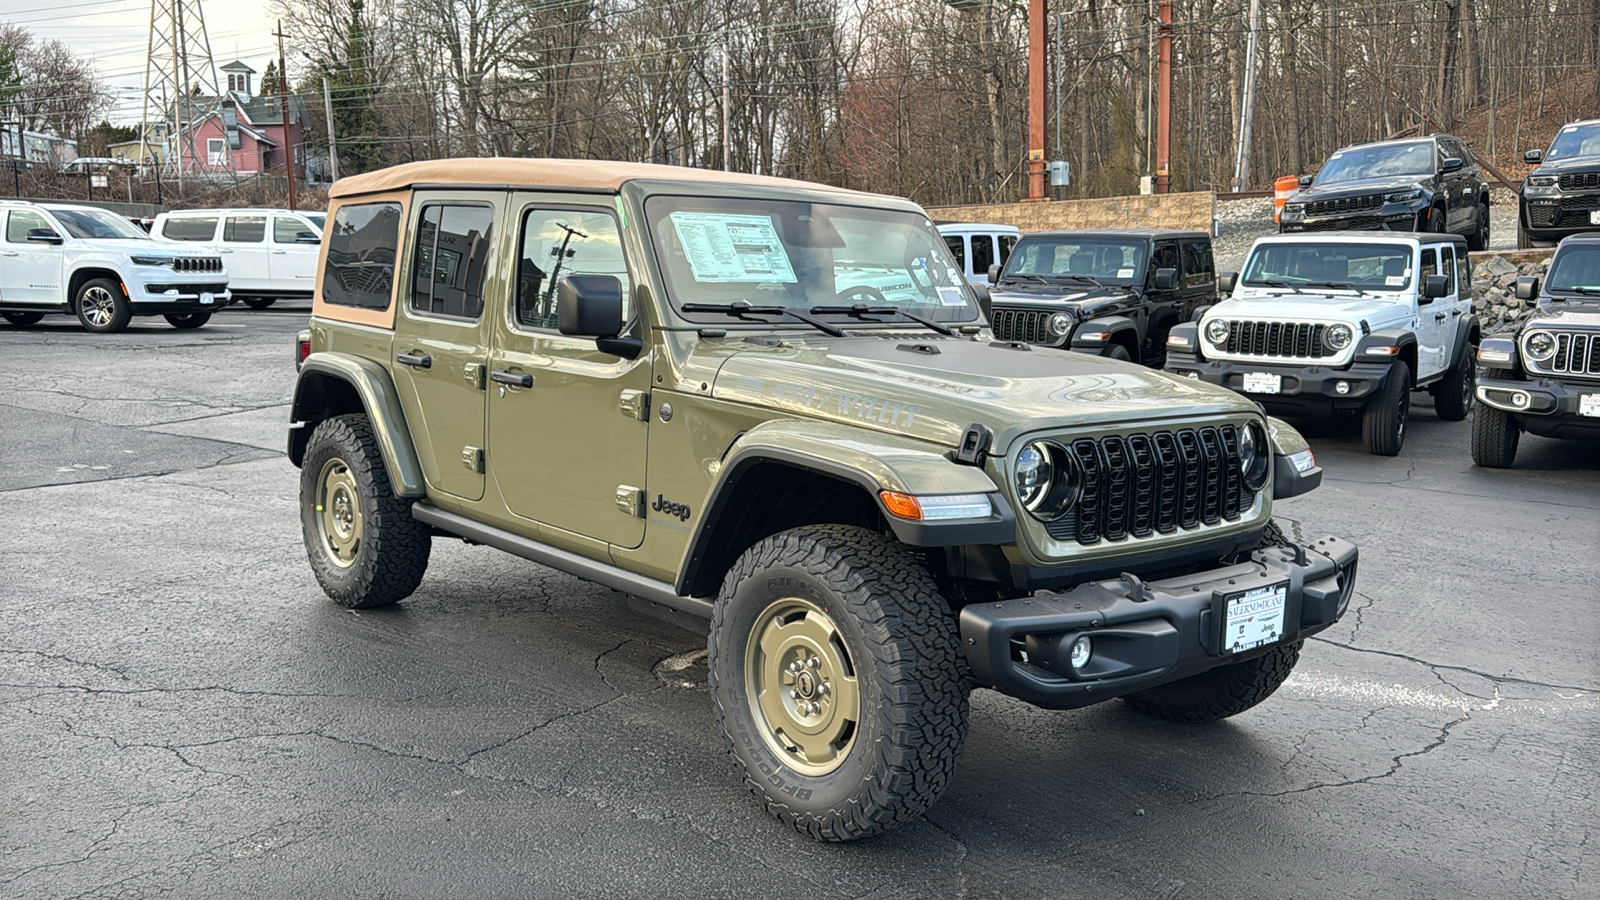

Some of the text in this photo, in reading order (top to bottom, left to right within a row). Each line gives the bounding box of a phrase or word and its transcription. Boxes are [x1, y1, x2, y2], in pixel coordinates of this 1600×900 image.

[876, 283, 912, 292] UBICON
[652, 494, 691, 522] Jeep
[1261, 623, 1275, 633] Jeep
